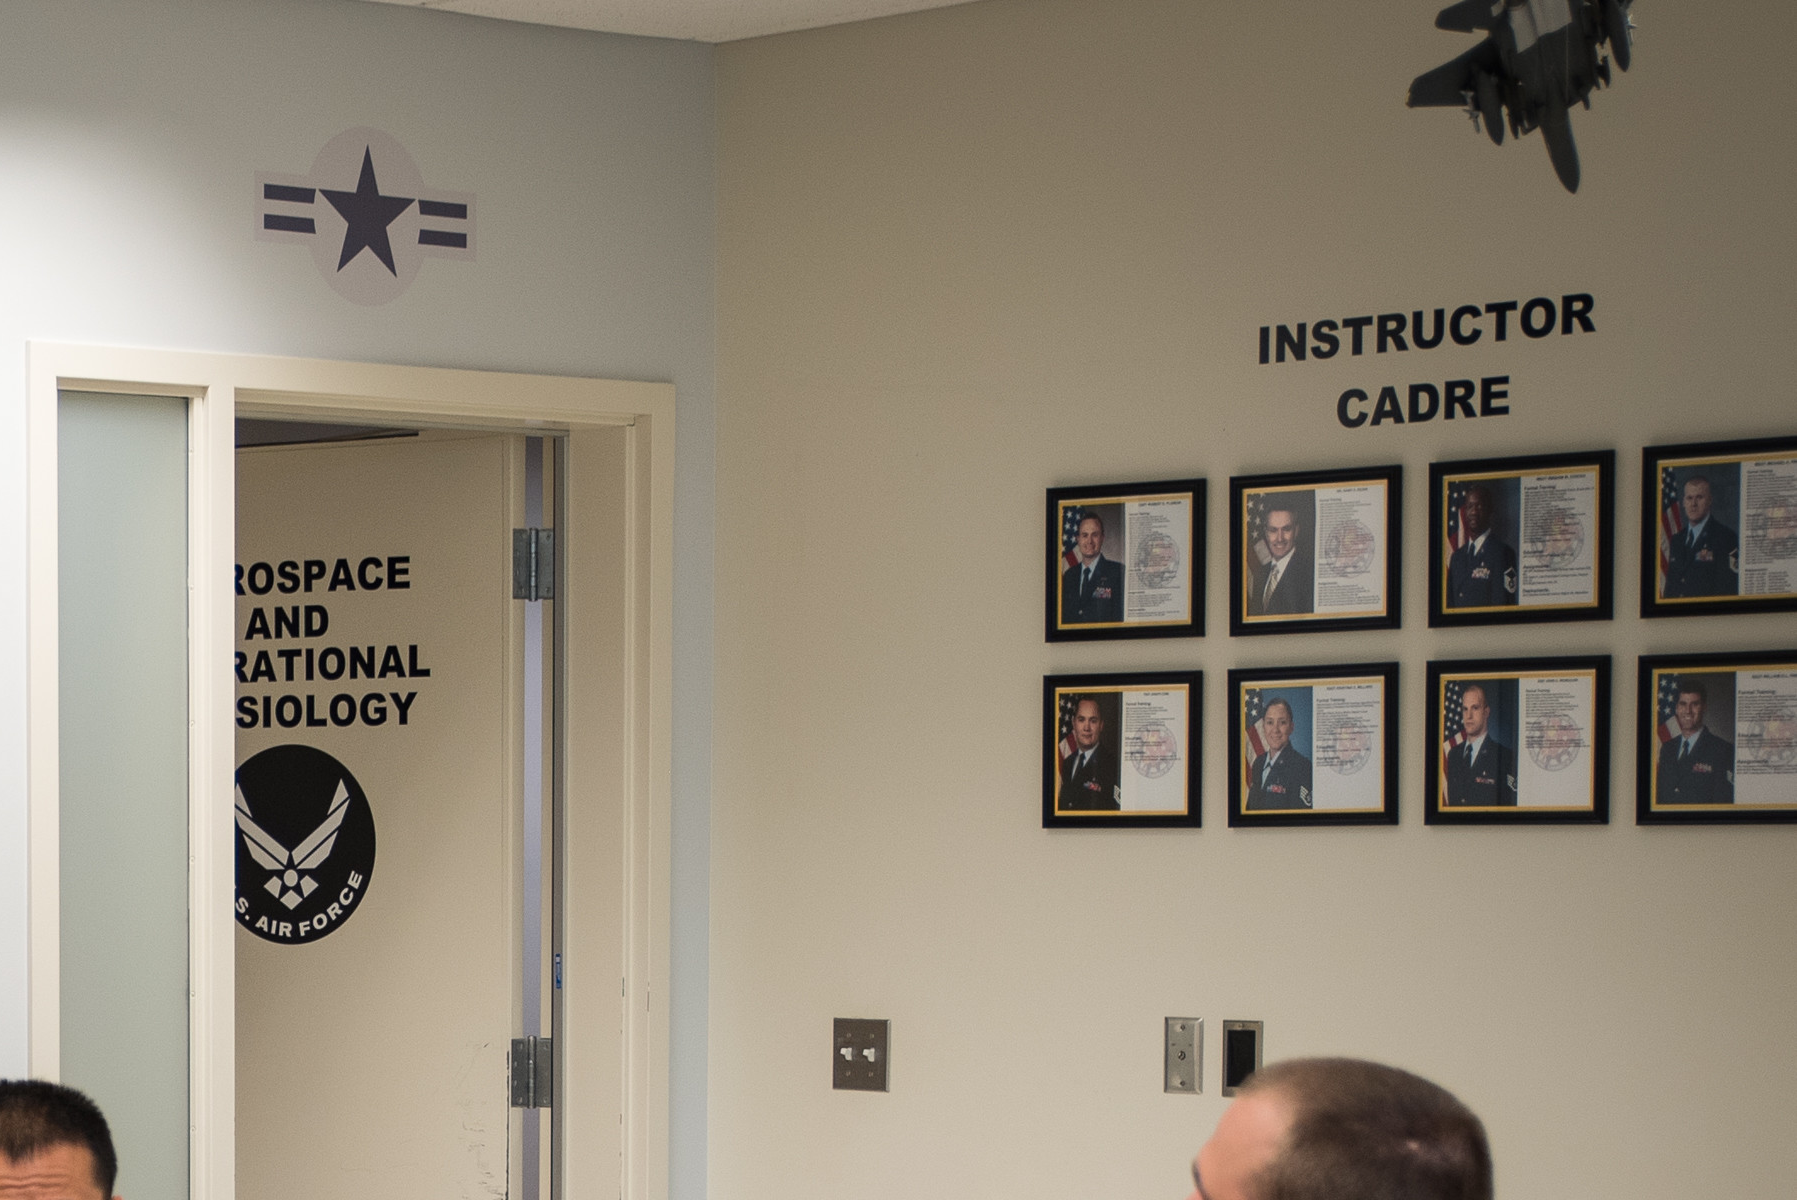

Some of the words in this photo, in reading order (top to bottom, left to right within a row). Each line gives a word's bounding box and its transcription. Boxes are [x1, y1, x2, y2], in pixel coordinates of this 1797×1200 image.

[1258, 292, 1597, 365] INSTRUCTOR
[1336, 375, 1510, 429] CADRE
[244, 604, 329, 641] AND
[235, 644, 431, 683] RATIONAL
[236, 692, 418, 729] SIOLOGY
[254, 915, 293, 938] AIR
[298, 870, 363, 937] FORCE
